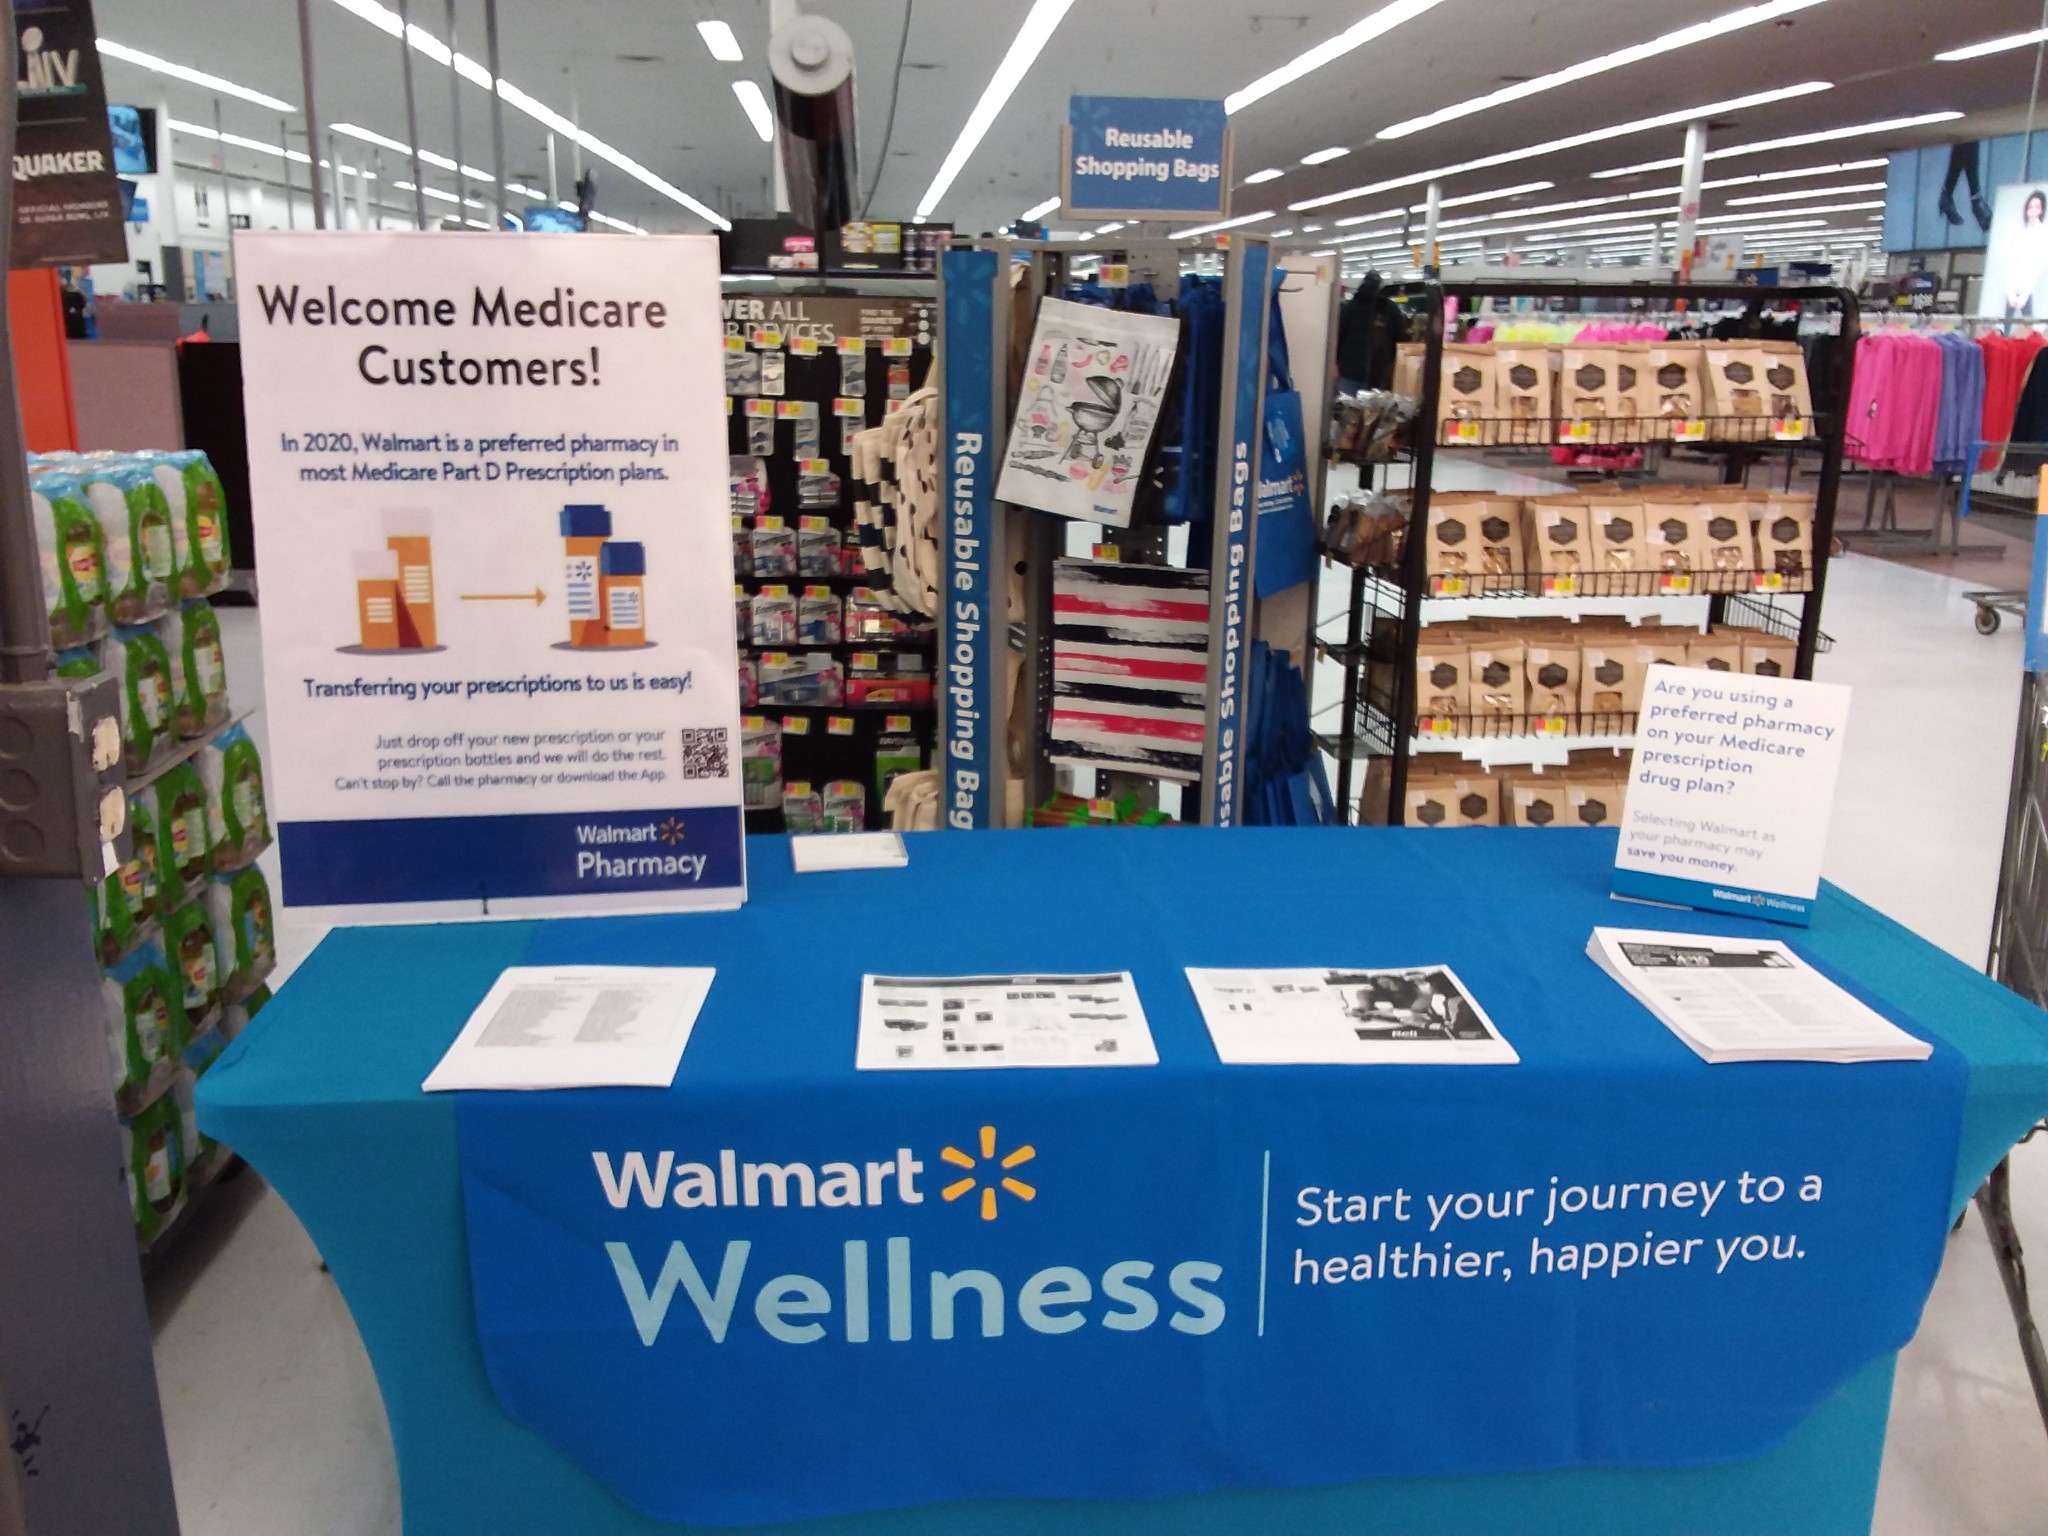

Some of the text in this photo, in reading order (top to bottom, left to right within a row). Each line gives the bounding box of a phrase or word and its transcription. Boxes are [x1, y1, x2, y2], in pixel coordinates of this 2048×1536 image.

[1105, 127, 1194, 149] Reusable
[12, 150, 104, 181] QUAKER
[1075, 155, 1220, 182] Shopping Bags
[257, 284, 668, 328] Welcome Medicare
[770, 301, 810, 320] ALL
[358, 344, 601, 387] Customers!
[280, 431, 679, 457] In 2020, Walmart is a preferred pharmacy in
[300, 462, 670, 486] most Medicare Part D Prescription plans.
[1229, 442, 1249, 533] Bags
[954, 432, 983, 591] Reusable
[1220, 544, 1245, 720] Shopping
[303, 671, 693, 700] Transferring your prescriptions to us is easy!
[949, 601, 980, 761] Shopping
[1654, 680, 1793, 710] Are you using a
[1650, 704, 1835, 738] preferred pharmacy
[375, 730, 665, 753] Just drop off your new prescription or your
[1646, 726, 1806, 758] on your Medicare
[378, 752, 462, 772] prescription
[465, 751, 513, 768] bottles
[516, 751, 541, 765] and
[544, 753, 564, 764] we
[567, 748, 589, 763] will
[592, 748, 609, 763] do
[612, 748, 634, 762] the
[1642, 749, 1753, 775] prescription
[335, 775, 368, 791] Can't
[371, 775, 400, 793] stop
[402, 774, 424, 793] by?
[427, 773, 451, 787] Call
[453, 773, 474, 787] the
[477, 770, 537, 788] pharmacy
[540, 774, 553, 784] or
[556, 769, 616, 785] download
[618, 768, 639, 782] the
[1639, 770, 1736, 795] drug plan?
[576, 824, 657, 845] Walmart
[1633, 810, 1777, 843] Selecting Walmart as
[1626, 846, 1738, 873] save you money.
[1629, 829, 1764, 860] your pharmacy may
[577, 851, 707, 882] Pharmacy
[1712, 888, 1805, 913] Walmart Wellness
[591, 1147, 925, 1209] Walmart
[1296, 1170, 1823, 1231] Start your journey to a
[1292, 1230, 1807, 1286] healthier, happier you.
[604, 1236, 1227, 1347] Wellness
